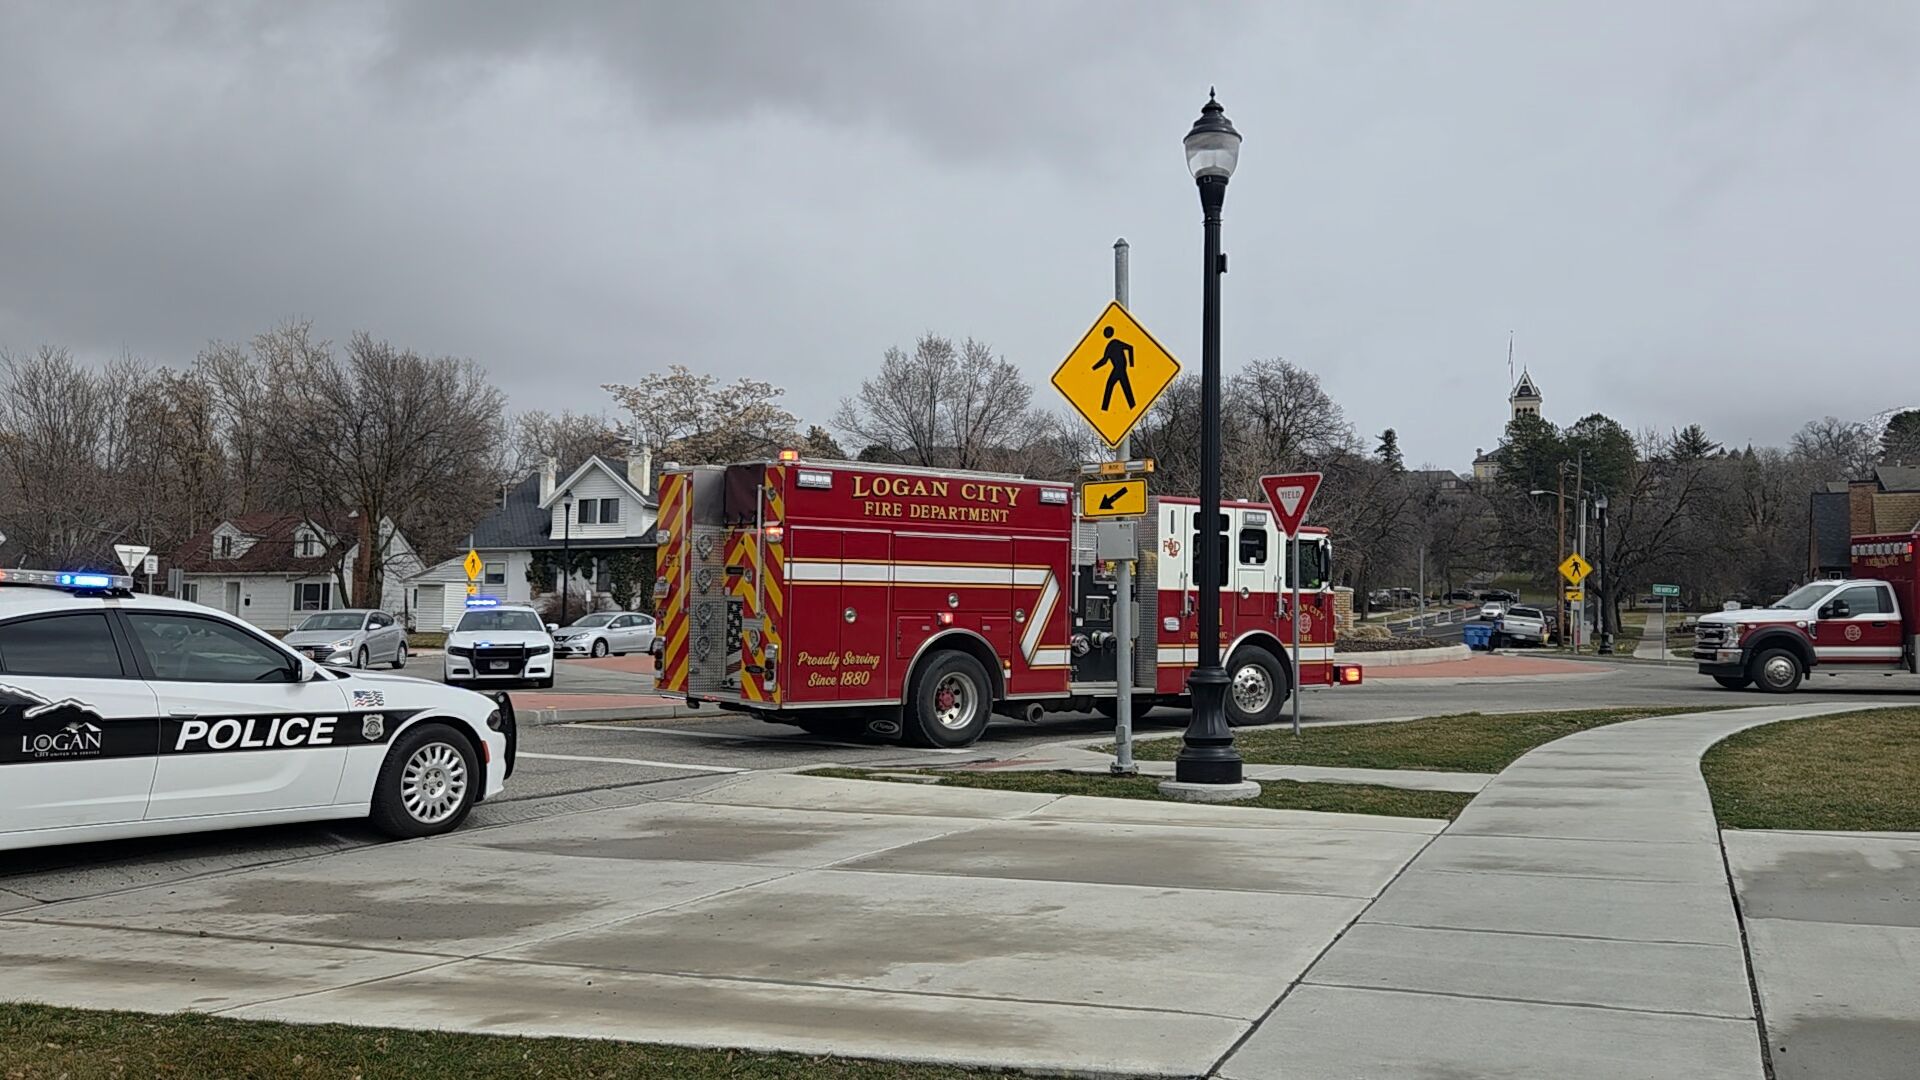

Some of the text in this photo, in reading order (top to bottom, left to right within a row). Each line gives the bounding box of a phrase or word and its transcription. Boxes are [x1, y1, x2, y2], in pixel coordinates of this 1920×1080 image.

[852, 476, 1021, 507] LOGAN CITY
[1281, 490, 1300, 499] YIELD
[864, 501, 1010, 523] FIRE DEPARTMENT
[1309, 605, 1325, 621] CITY
[798, 651, 881, 671] Proudly Serving
[807, 671, 870, 687] Since 1880
[22, 732, 102, 753] LOGAN
[175, 717, 338, 751] POLICE
